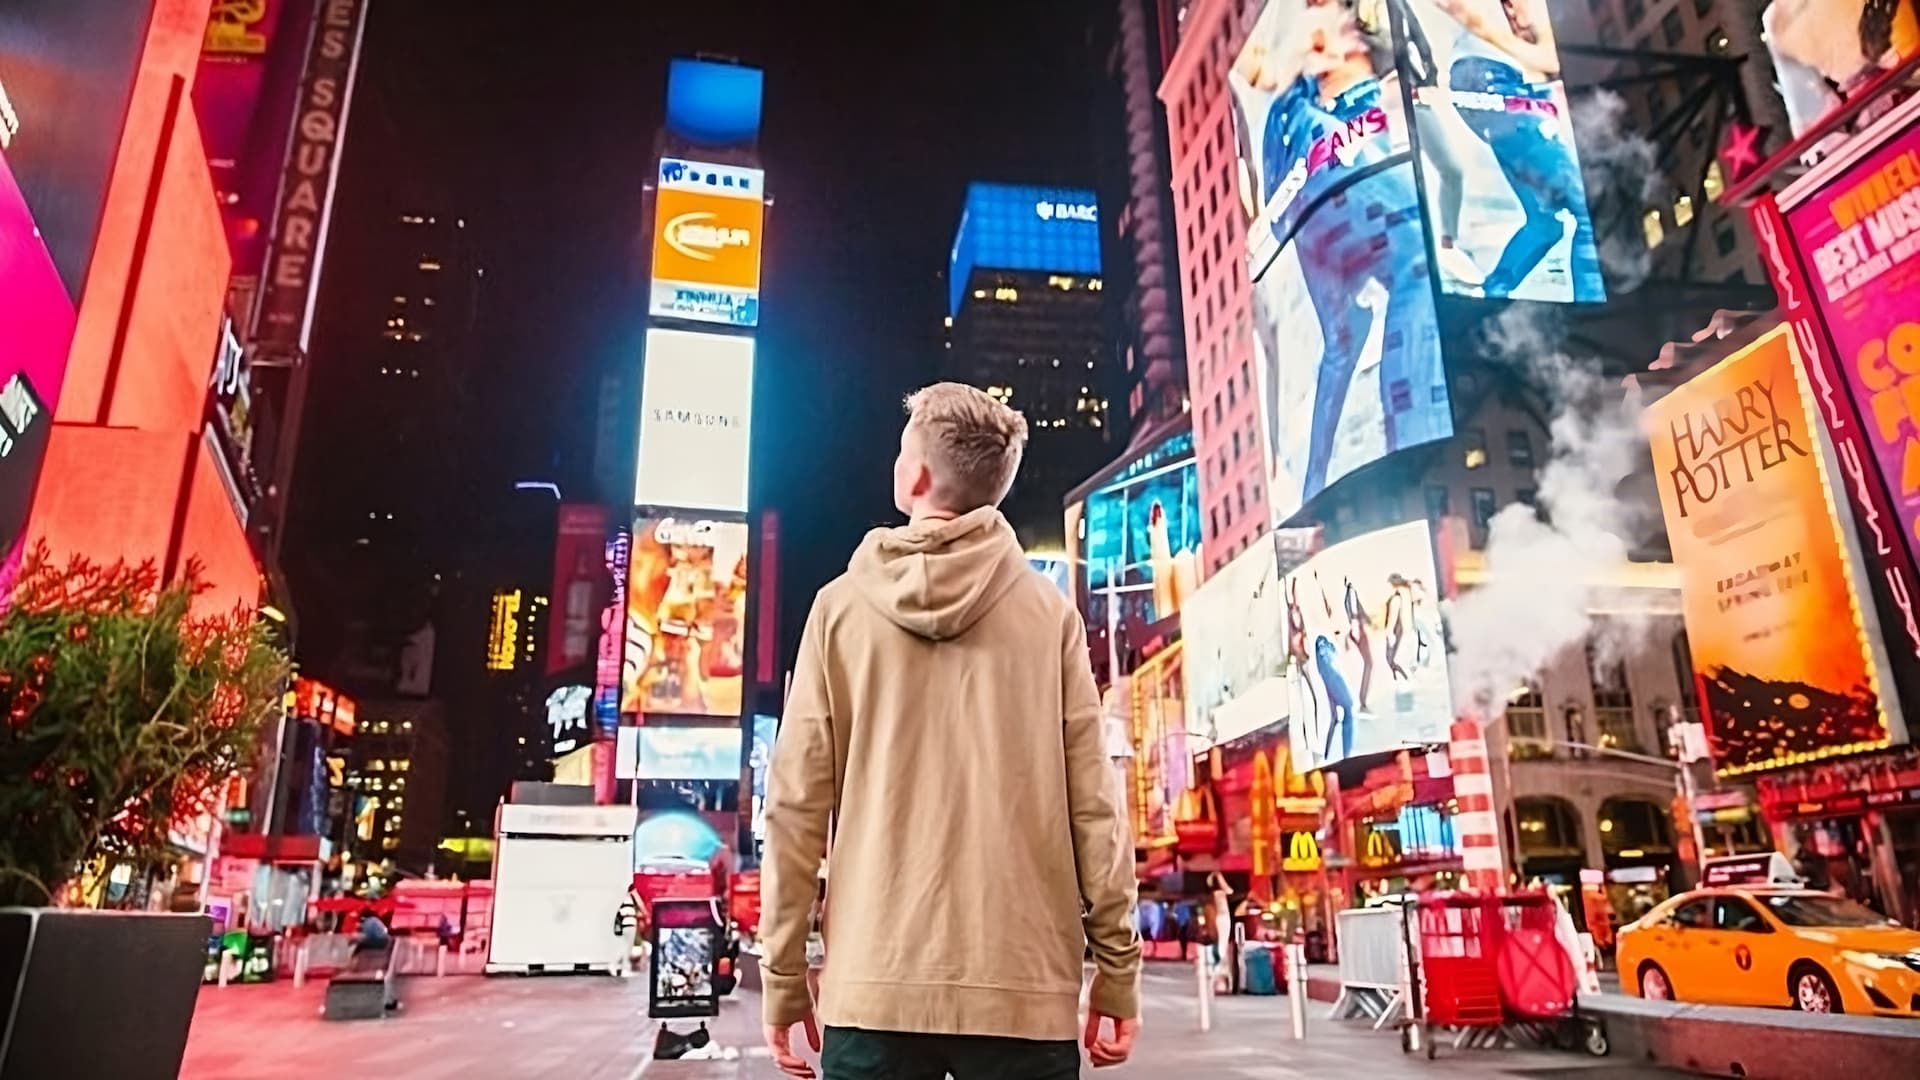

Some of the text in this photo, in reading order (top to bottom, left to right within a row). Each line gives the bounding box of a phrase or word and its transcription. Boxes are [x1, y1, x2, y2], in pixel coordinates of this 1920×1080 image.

[275, 78, 336, 288] SQUARE
[1812, 223, 1870, 285] BEST
[1669, 419, 1808, 518] POTTER
[1670, 378, 1776, 468] HARRY
